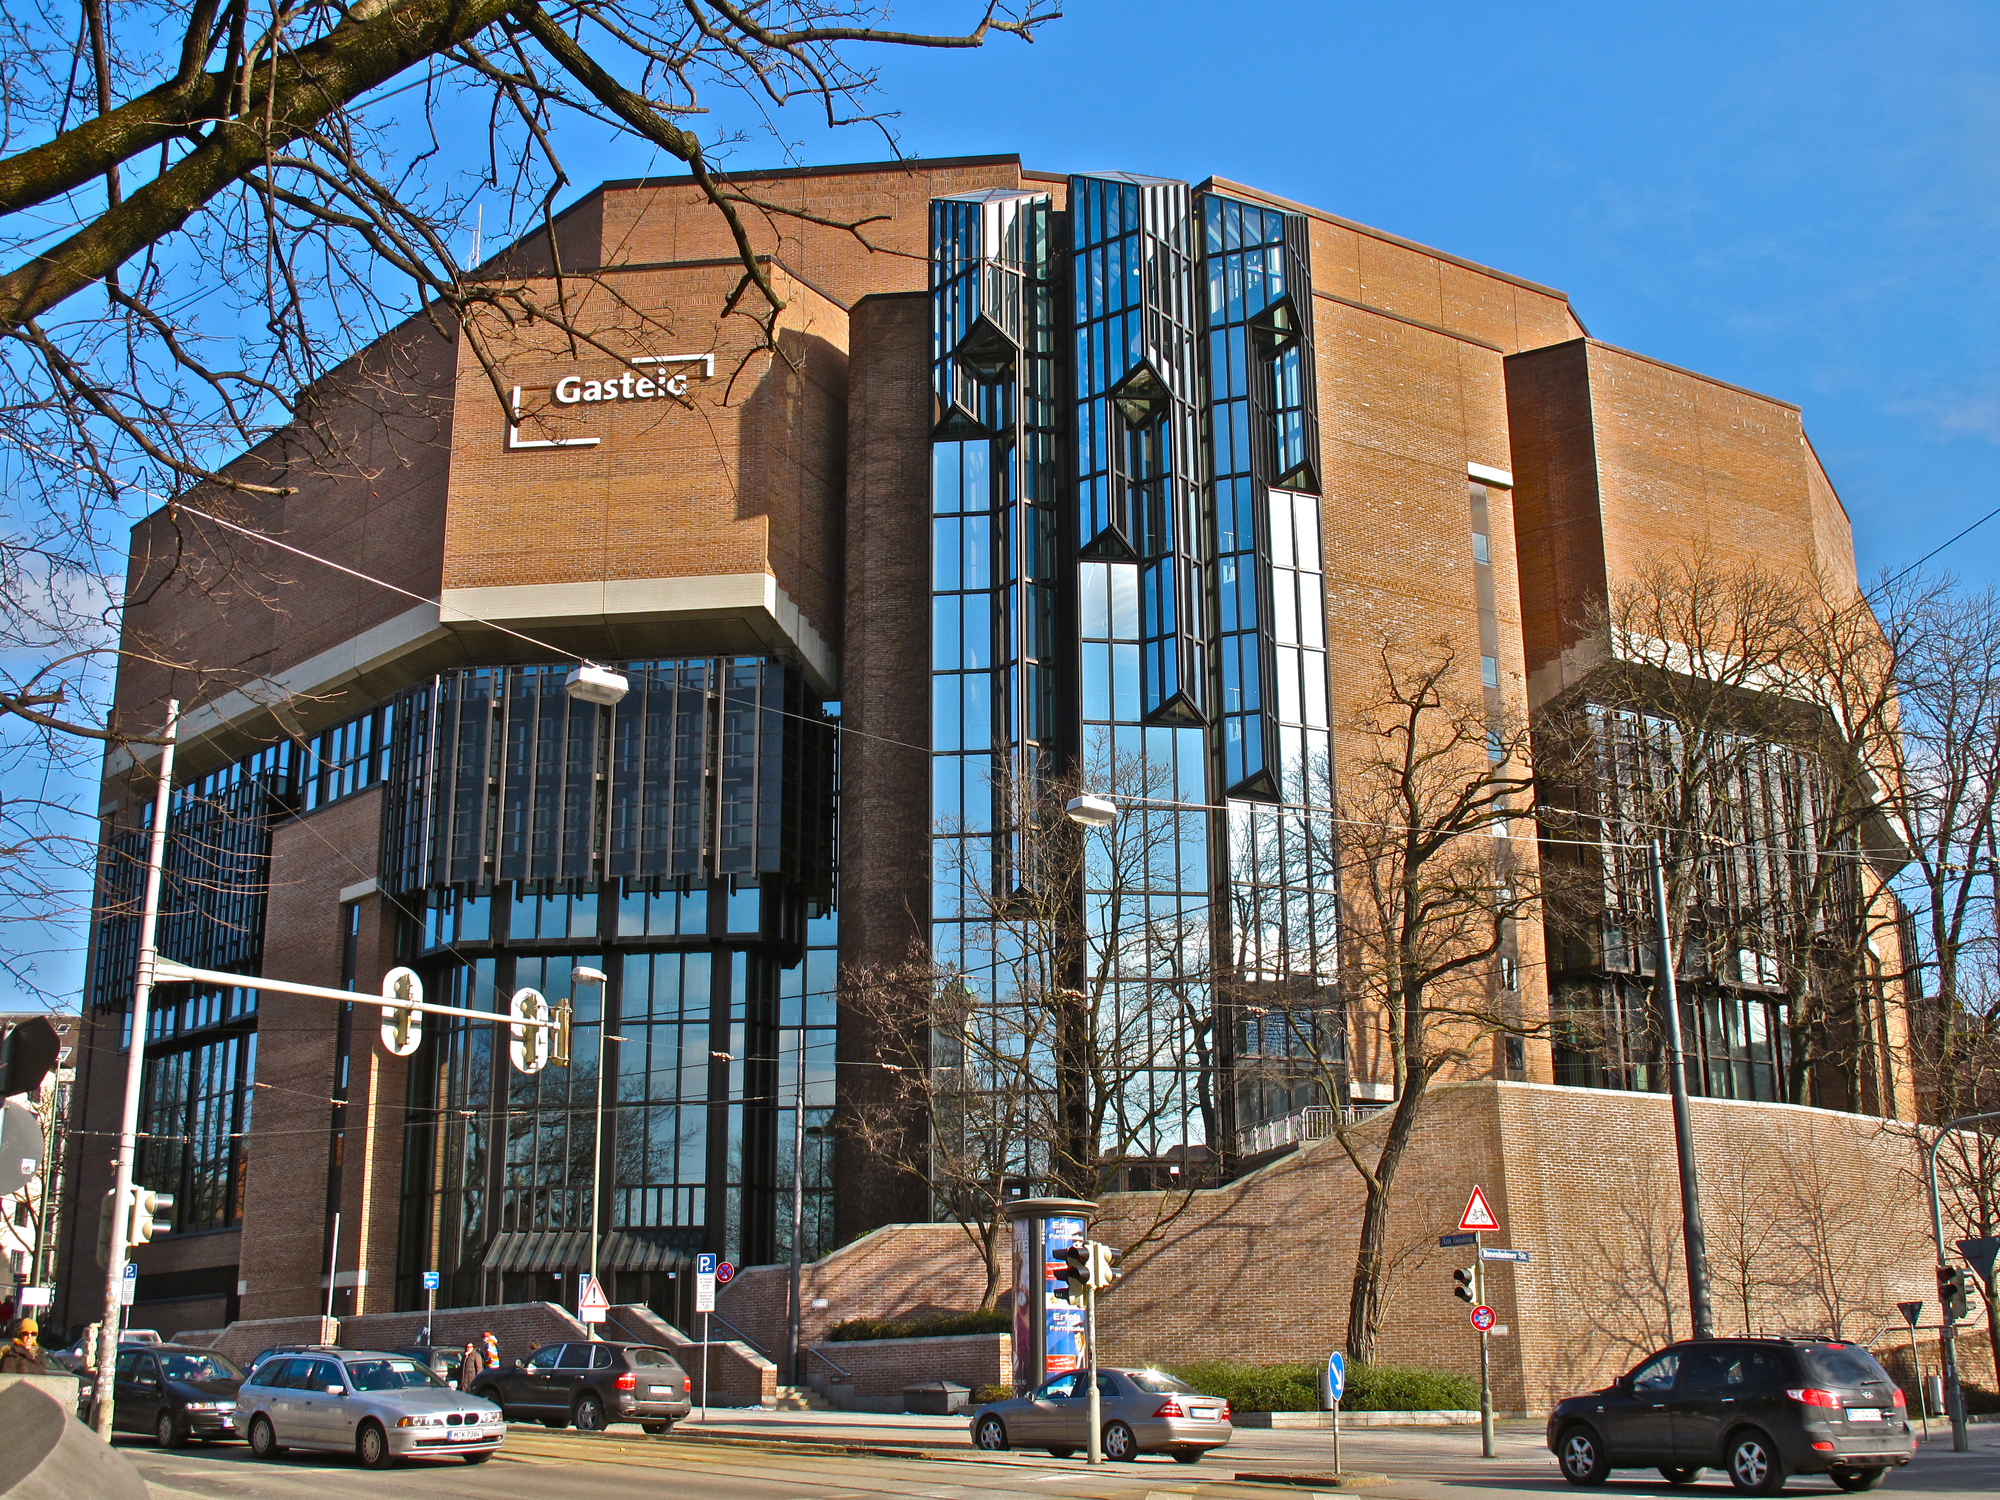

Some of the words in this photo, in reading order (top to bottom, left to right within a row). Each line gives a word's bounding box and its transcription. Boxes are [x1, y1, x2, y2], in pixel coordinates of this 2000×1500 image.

[555, 368, 687, 403] Gasteig
[1052, 1221, 1080, 1233] Erfolg
[1483, 1249, 1517, 1259] Rosenheimer
[1518, 1251, 1528, 1260] Str.
[700, 1256, 710, 1272] P
[126, 1265, 133, 1277] P
[1053, 1312, 1081, 1323] Erfolg
